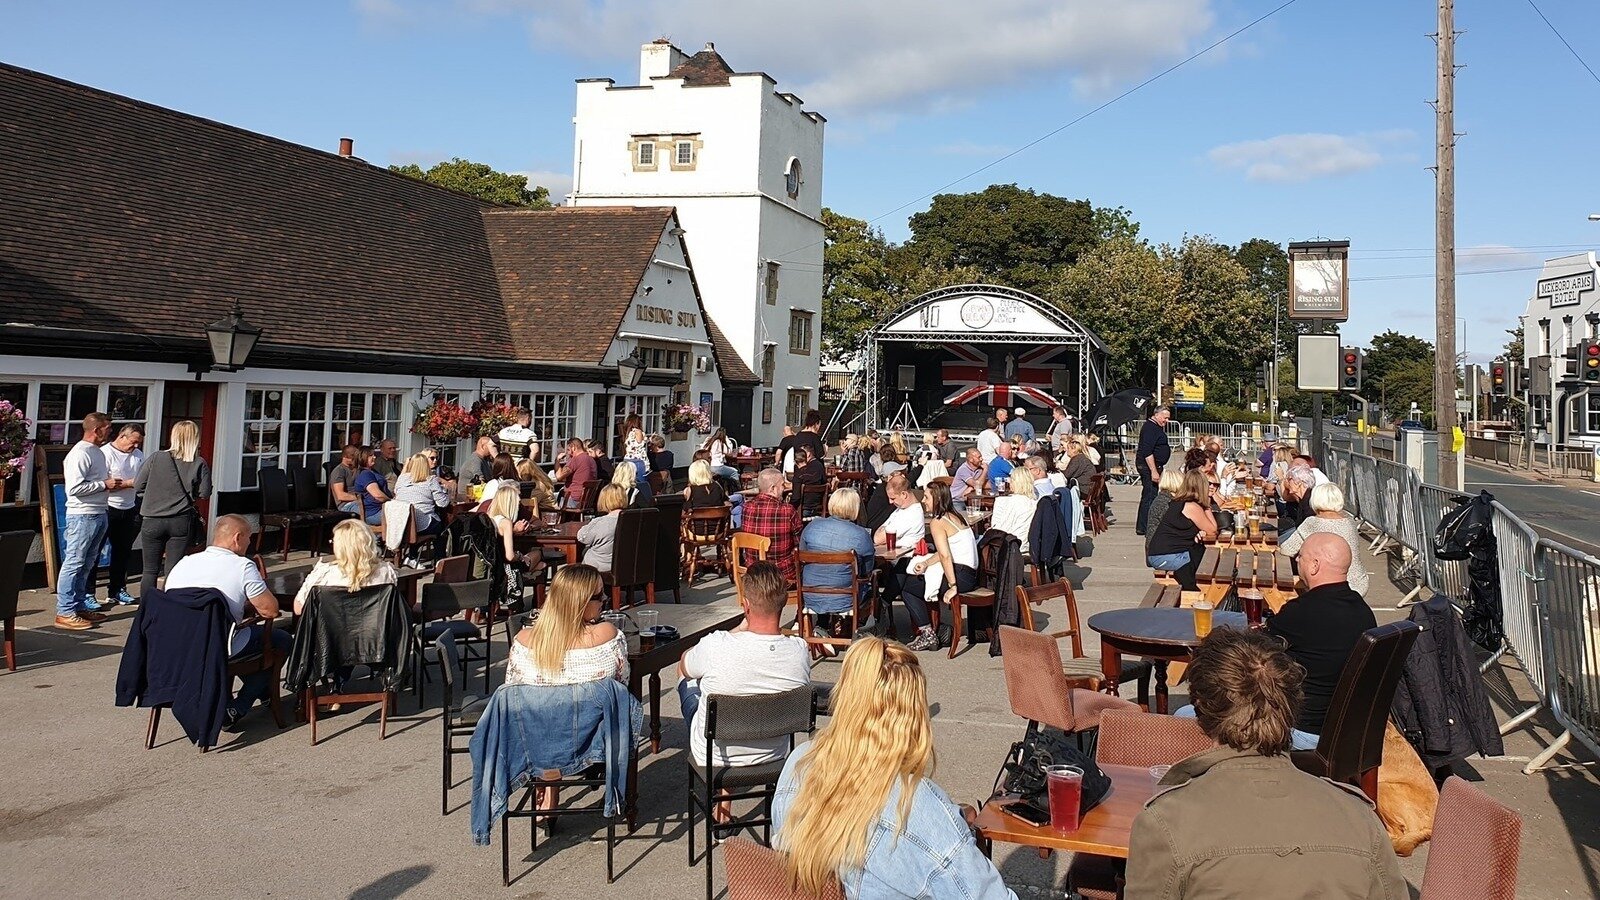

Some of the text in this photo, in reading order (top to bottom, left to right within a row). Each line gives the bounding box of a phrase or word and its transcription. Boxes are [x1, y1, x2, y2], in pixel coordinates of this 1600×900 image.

[1571, 276, 1591, 290] ARMS
[1297, 295, 1339, 303] RISING SUN
[1554, 291, 1577, 304] HOTEL
[636, 304, 697, 328] RISING SUN
